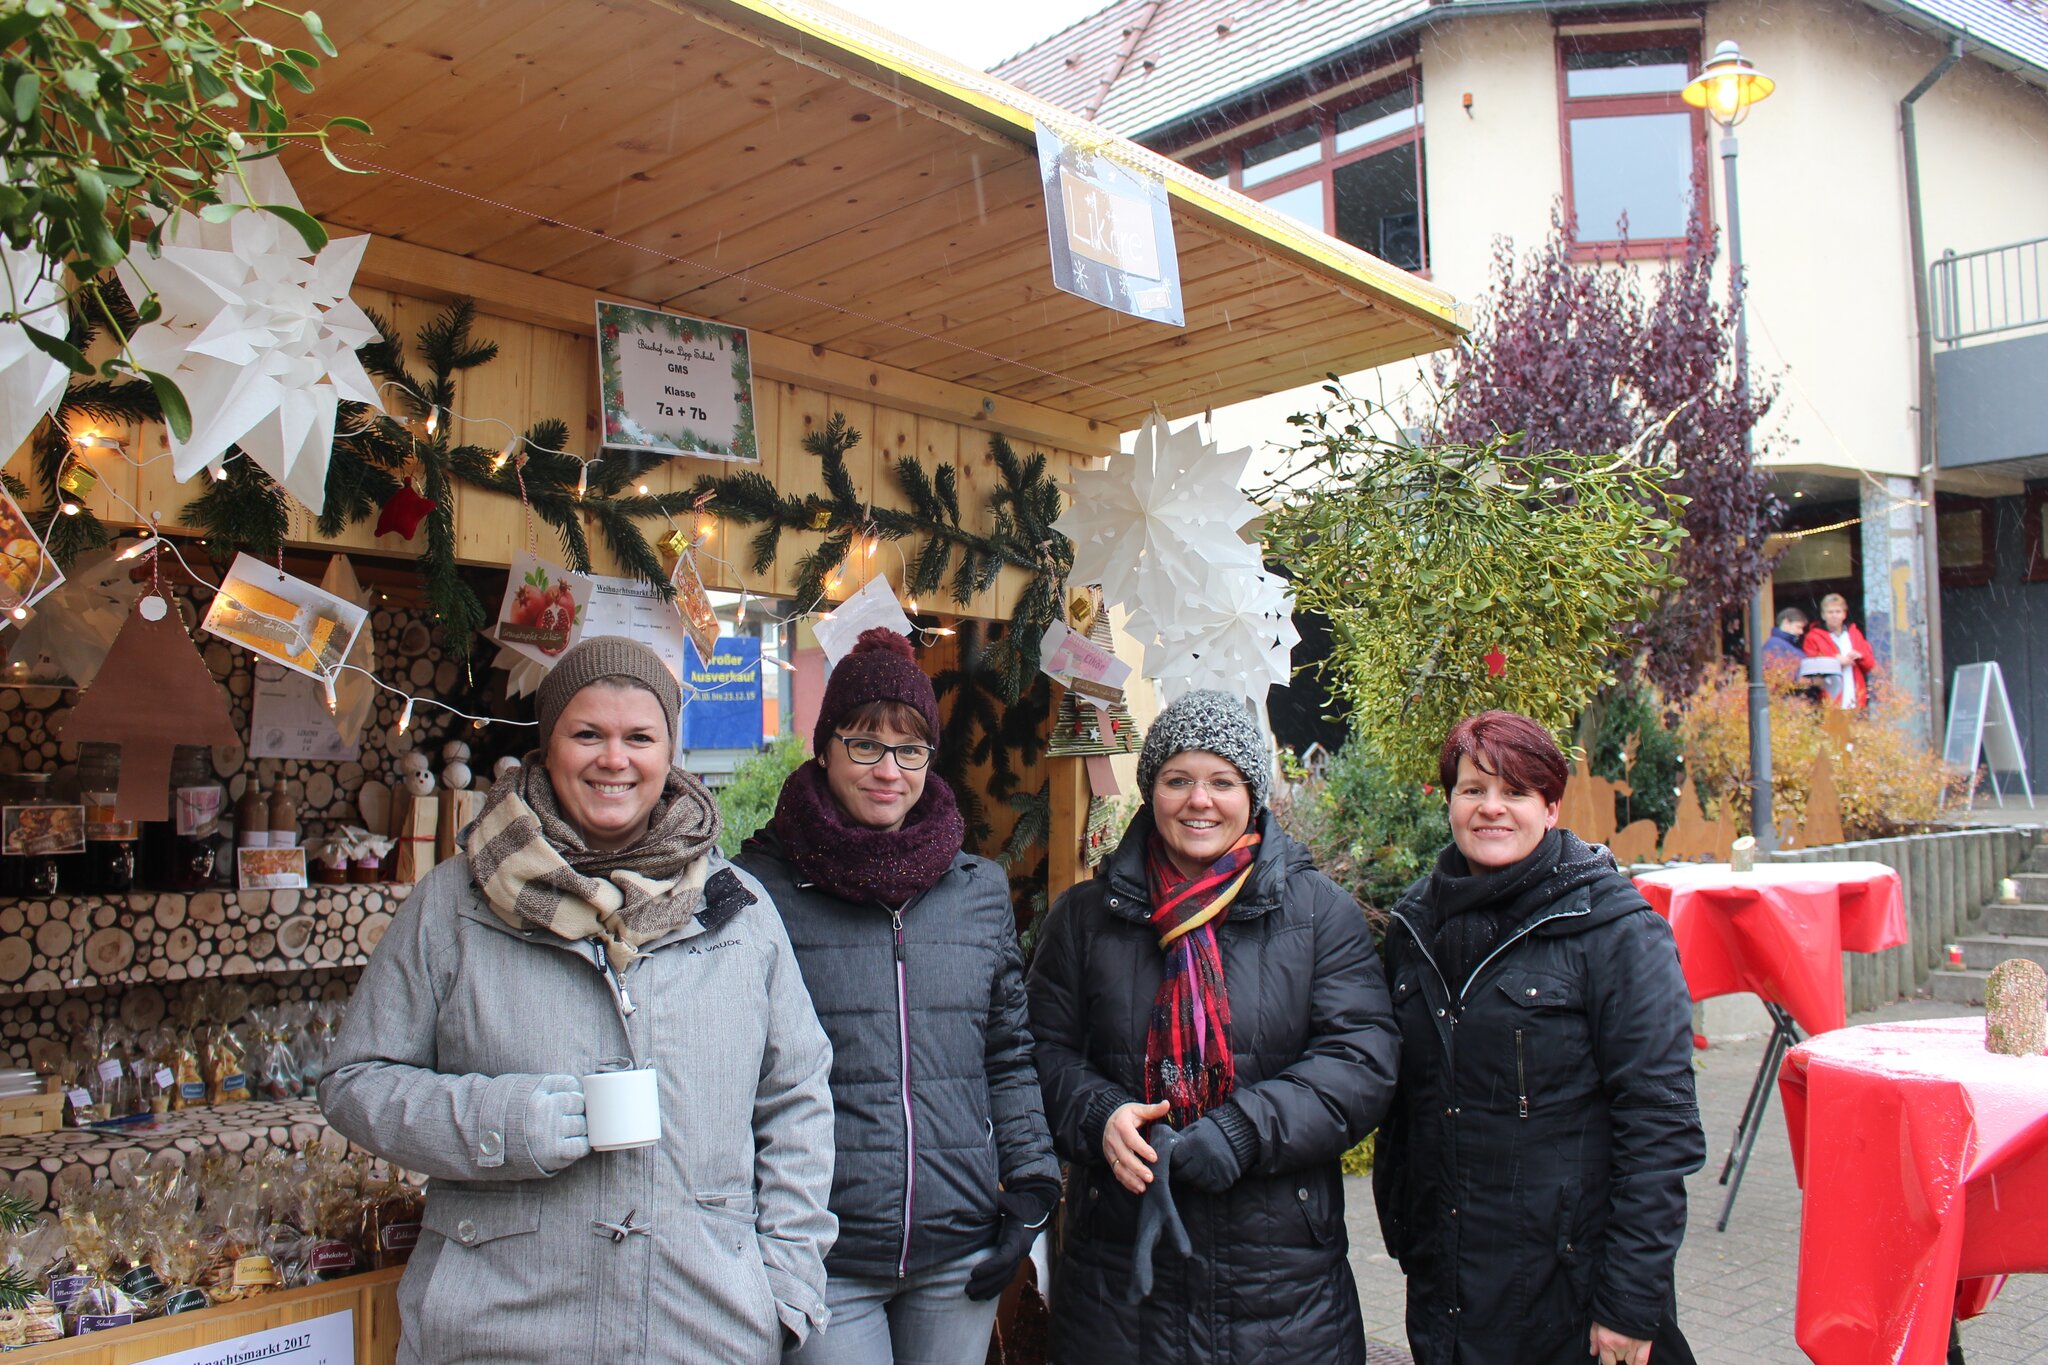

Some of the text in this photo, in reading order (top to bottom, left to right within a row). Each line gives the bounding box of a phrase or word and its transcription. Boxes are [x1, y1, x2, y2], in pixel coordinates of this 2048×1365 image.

[637, 338, 716, 361] Bischof von Lipp Schule
[668, 363, 689, 375] GMS
[664, 385, 696, 399] Klasse
[656, 402, 707, 421] 7a + 7b
[596, 584, 649, 598] Weihnachtsmarkt
[711, 653, 743, 666] roßer
[691, 670, 757, 683] Ausverkauf
[705, 939, 743, 952] VAUDE
[284, 1333, 311, 1351] 2017
